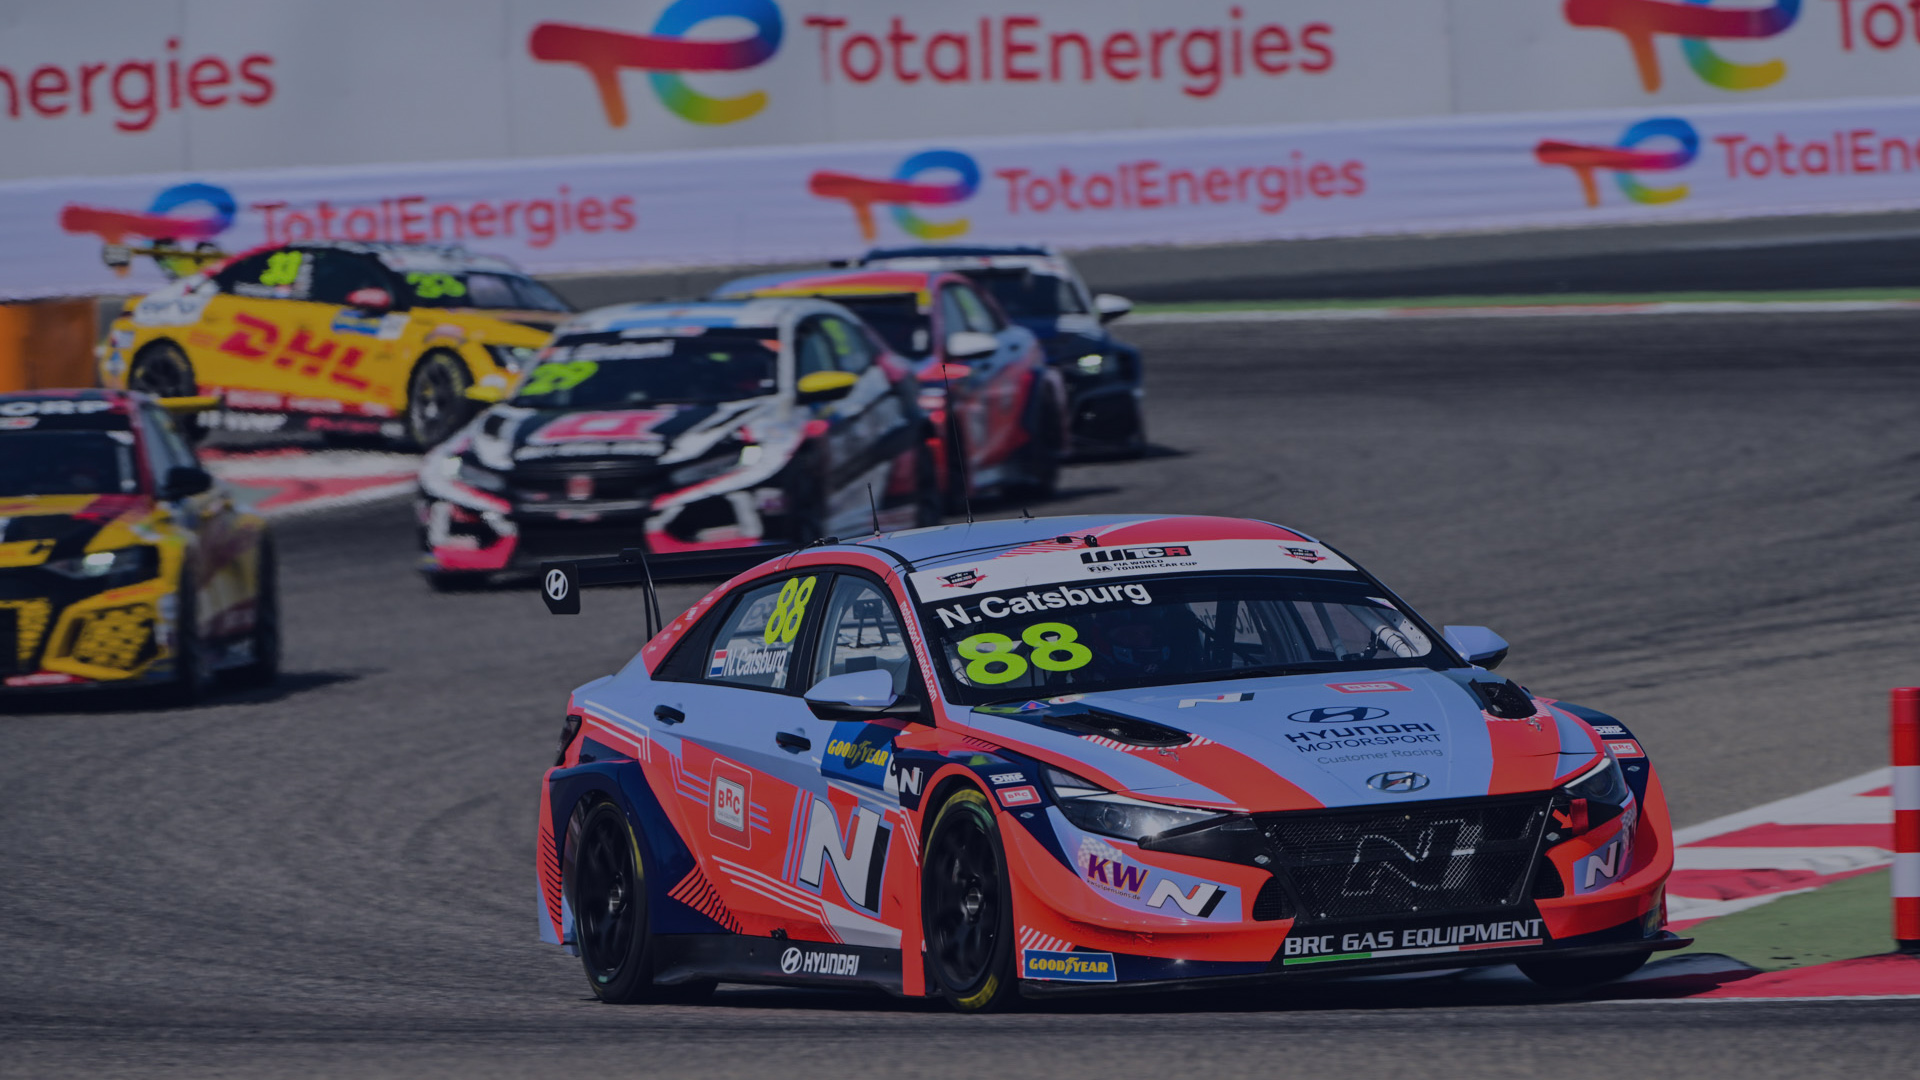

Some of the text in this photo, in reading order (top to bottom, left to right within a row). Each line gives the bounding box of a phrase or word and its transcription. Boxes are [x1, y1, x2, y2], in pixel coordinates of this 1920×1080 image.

[804, 7, 1335, 99] TotalEnergies
[1713, 129, 1920, 179] TotalEn
[995, 151, 1366, 213] TotalEnergies
[252, 185, 636, 248] TotalEnergies
[220, 313, 370, 391] DHL
[764, 576, 817, 644] 88
[957, 621, 1093, 685] 88
[1285, 722, 1436, 743] HYUNDAI
[1297, 733, 1442, 753] MOTORSPORT
[827, 739, 889, 767] GOODYEAR
[1317, 747, 1444, 765] Customer Racing
[718, 787, 741, 815] BRC
[1087, 853, 1150, 895] KW
[1285, 918, 1543, 957] BRC GAS EQUIPMENT
[803, 951, 860, 976] HYUNDAI
[1029, 957, 1108, 975] GOODYEAR
